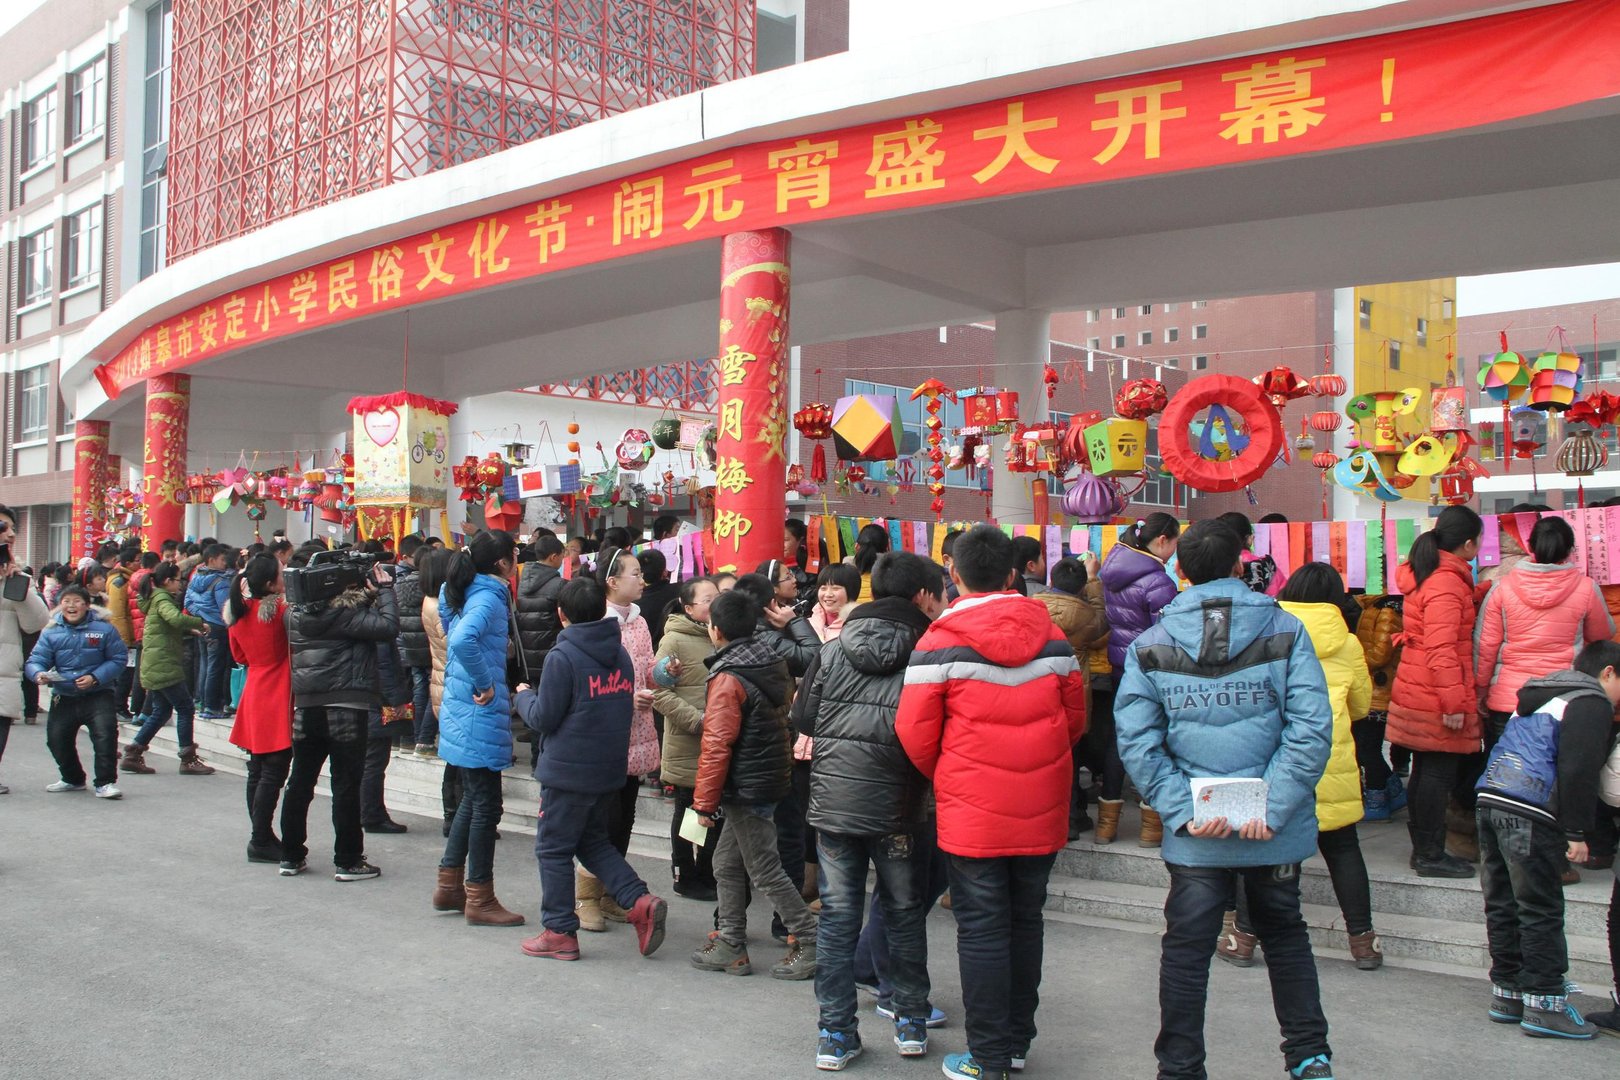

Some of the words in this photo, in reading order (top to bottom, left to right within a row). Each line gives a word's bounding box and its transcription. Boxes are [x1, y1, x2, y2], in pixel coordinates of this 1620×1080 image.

[1161, 683, 1209, 696] HALL
[1222, 679, 1272, 691] FAME
[1162, 689, 1279, 711] LAYOFFS
